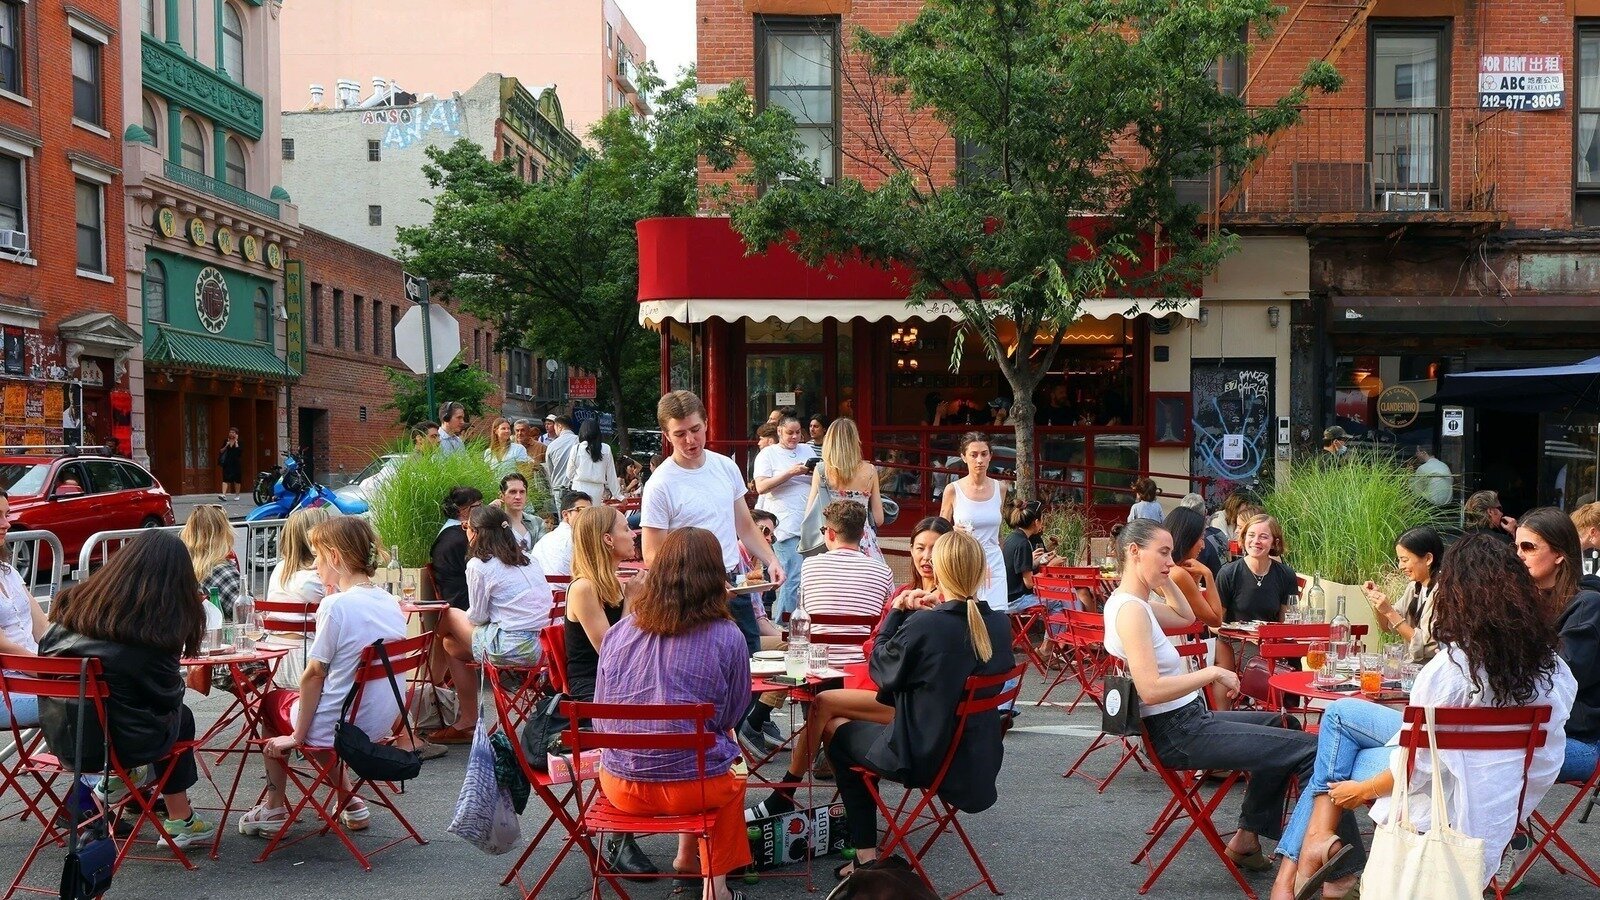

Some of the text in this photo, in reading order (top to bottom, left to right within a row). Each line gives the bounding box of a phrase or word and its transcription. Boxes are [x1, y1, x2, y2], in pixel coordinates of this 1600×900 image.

[1483, 56, 1527, 72] FOR RENT
[1529, 56, 1560, 72] 出租
[1500, 76, 1525, 90] ABC
[1482, 93, 1561, 110] 212-677-3605
[926, 302, 940, 314] Le
[1380, 402, 1416, 412] CLANDESTINO
[818, 811, 828, 853] LABOR
[763, 822, 774, 865] LABOR
